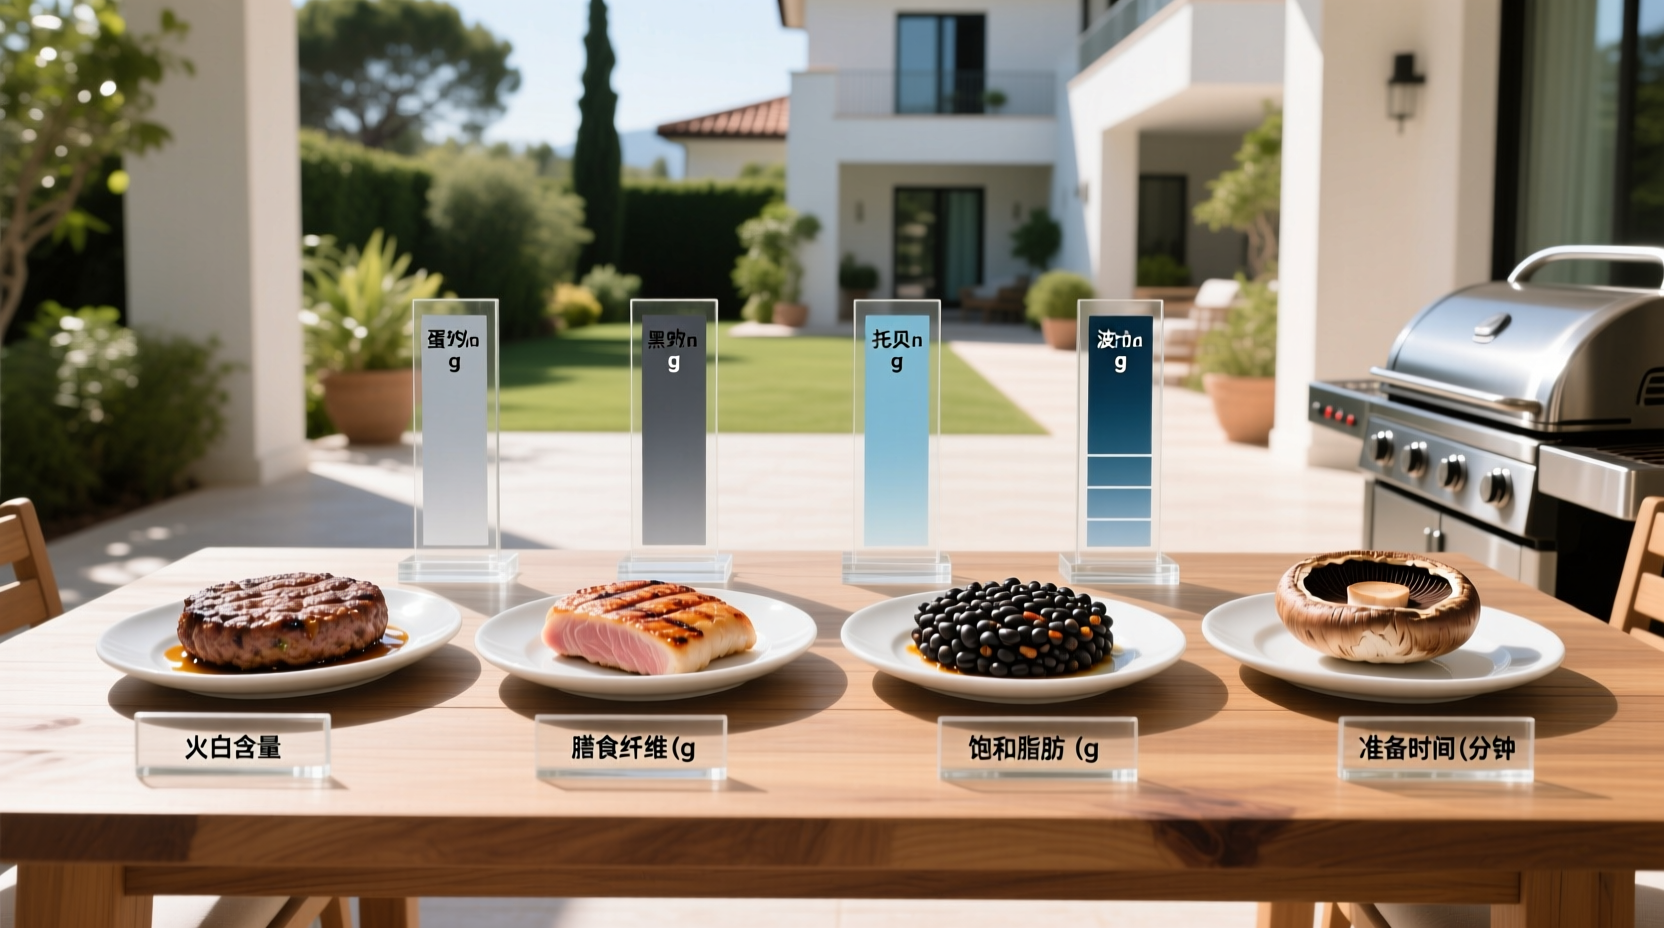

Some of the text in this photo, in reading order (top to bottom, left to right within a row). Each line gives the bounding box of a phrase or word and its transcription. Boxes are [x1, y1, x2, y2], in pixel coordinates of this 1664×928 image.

[448, 355, 461, 373] g
[667, 355, 681, 373] g
[890, 355, 903, 373] g
[1114, 355, 1128, 373] g
[185, 734, 281, 760] 火白含量
[1358, 734, 1516, 761] 准备时间(分钟
